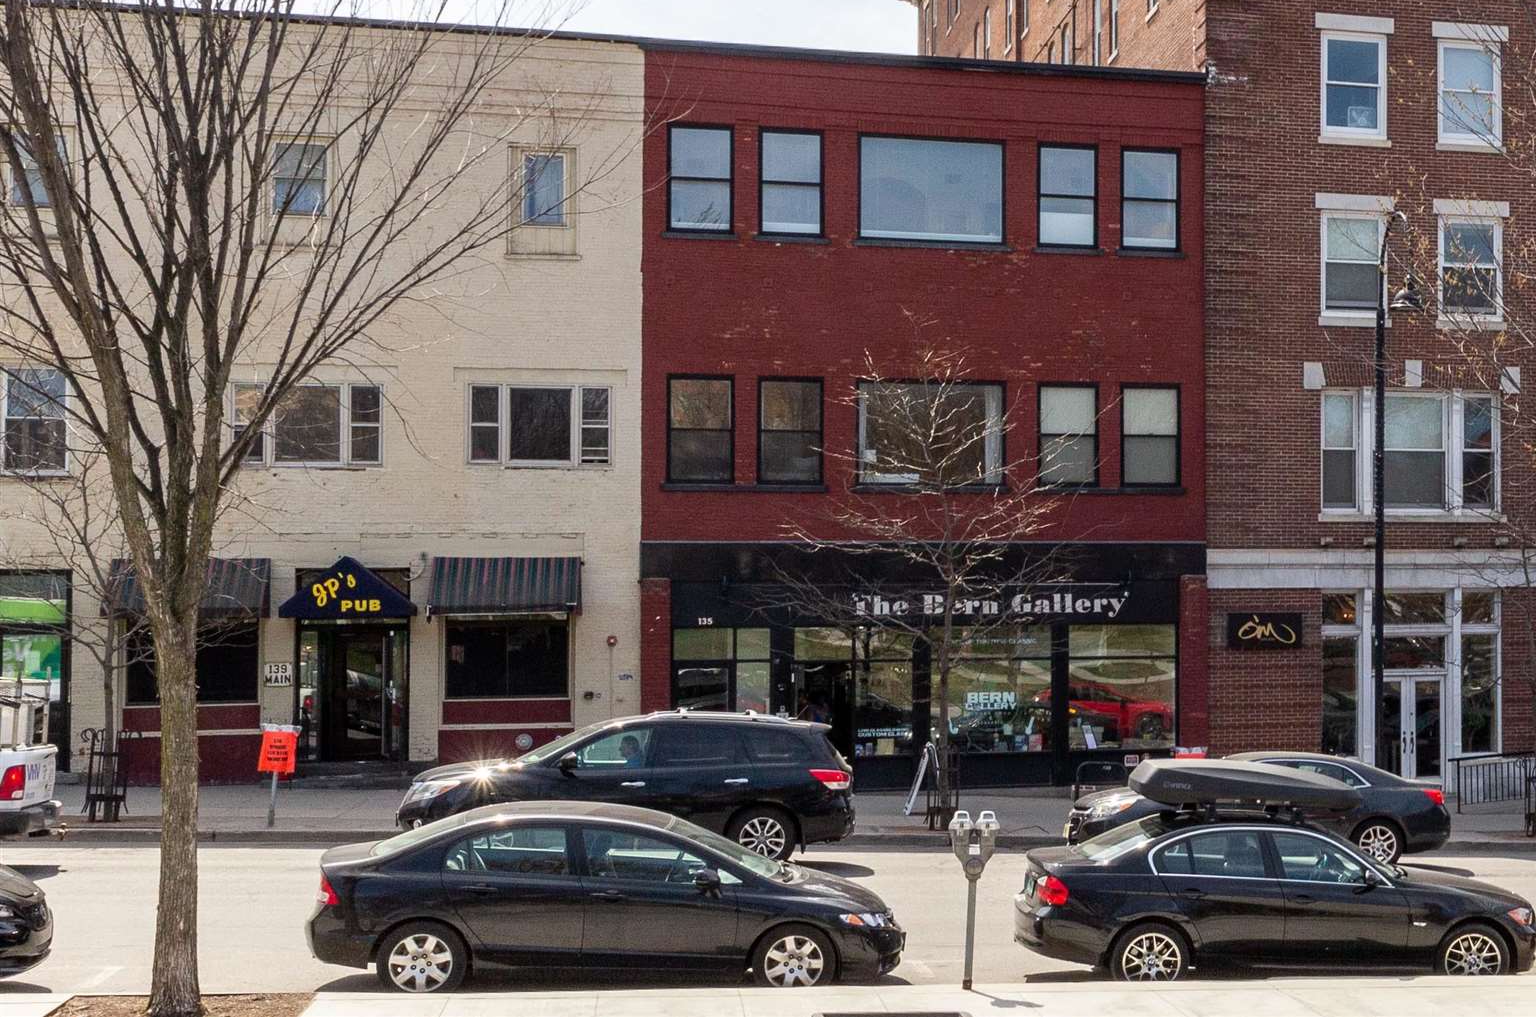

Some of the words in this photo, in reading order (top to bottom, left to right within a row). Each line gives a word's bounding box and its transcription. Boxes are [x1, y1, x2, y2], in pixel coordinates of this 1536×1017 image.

[312, 572, 356, 606] JP's
[340, 599, 382, 613] PUB
[852, 593, 911, 617] The
[922, 593, 999, 616] Bern
[1010, 592, 1129, 619] Gallery
[697, 616, 714, 626] 135
[268, 664, 288, 674] 139
[264, 674, 292, 684] MAIN
[967, 691, 1016, 704] BERN
[965, 703, 1017, 711] GLLERY
